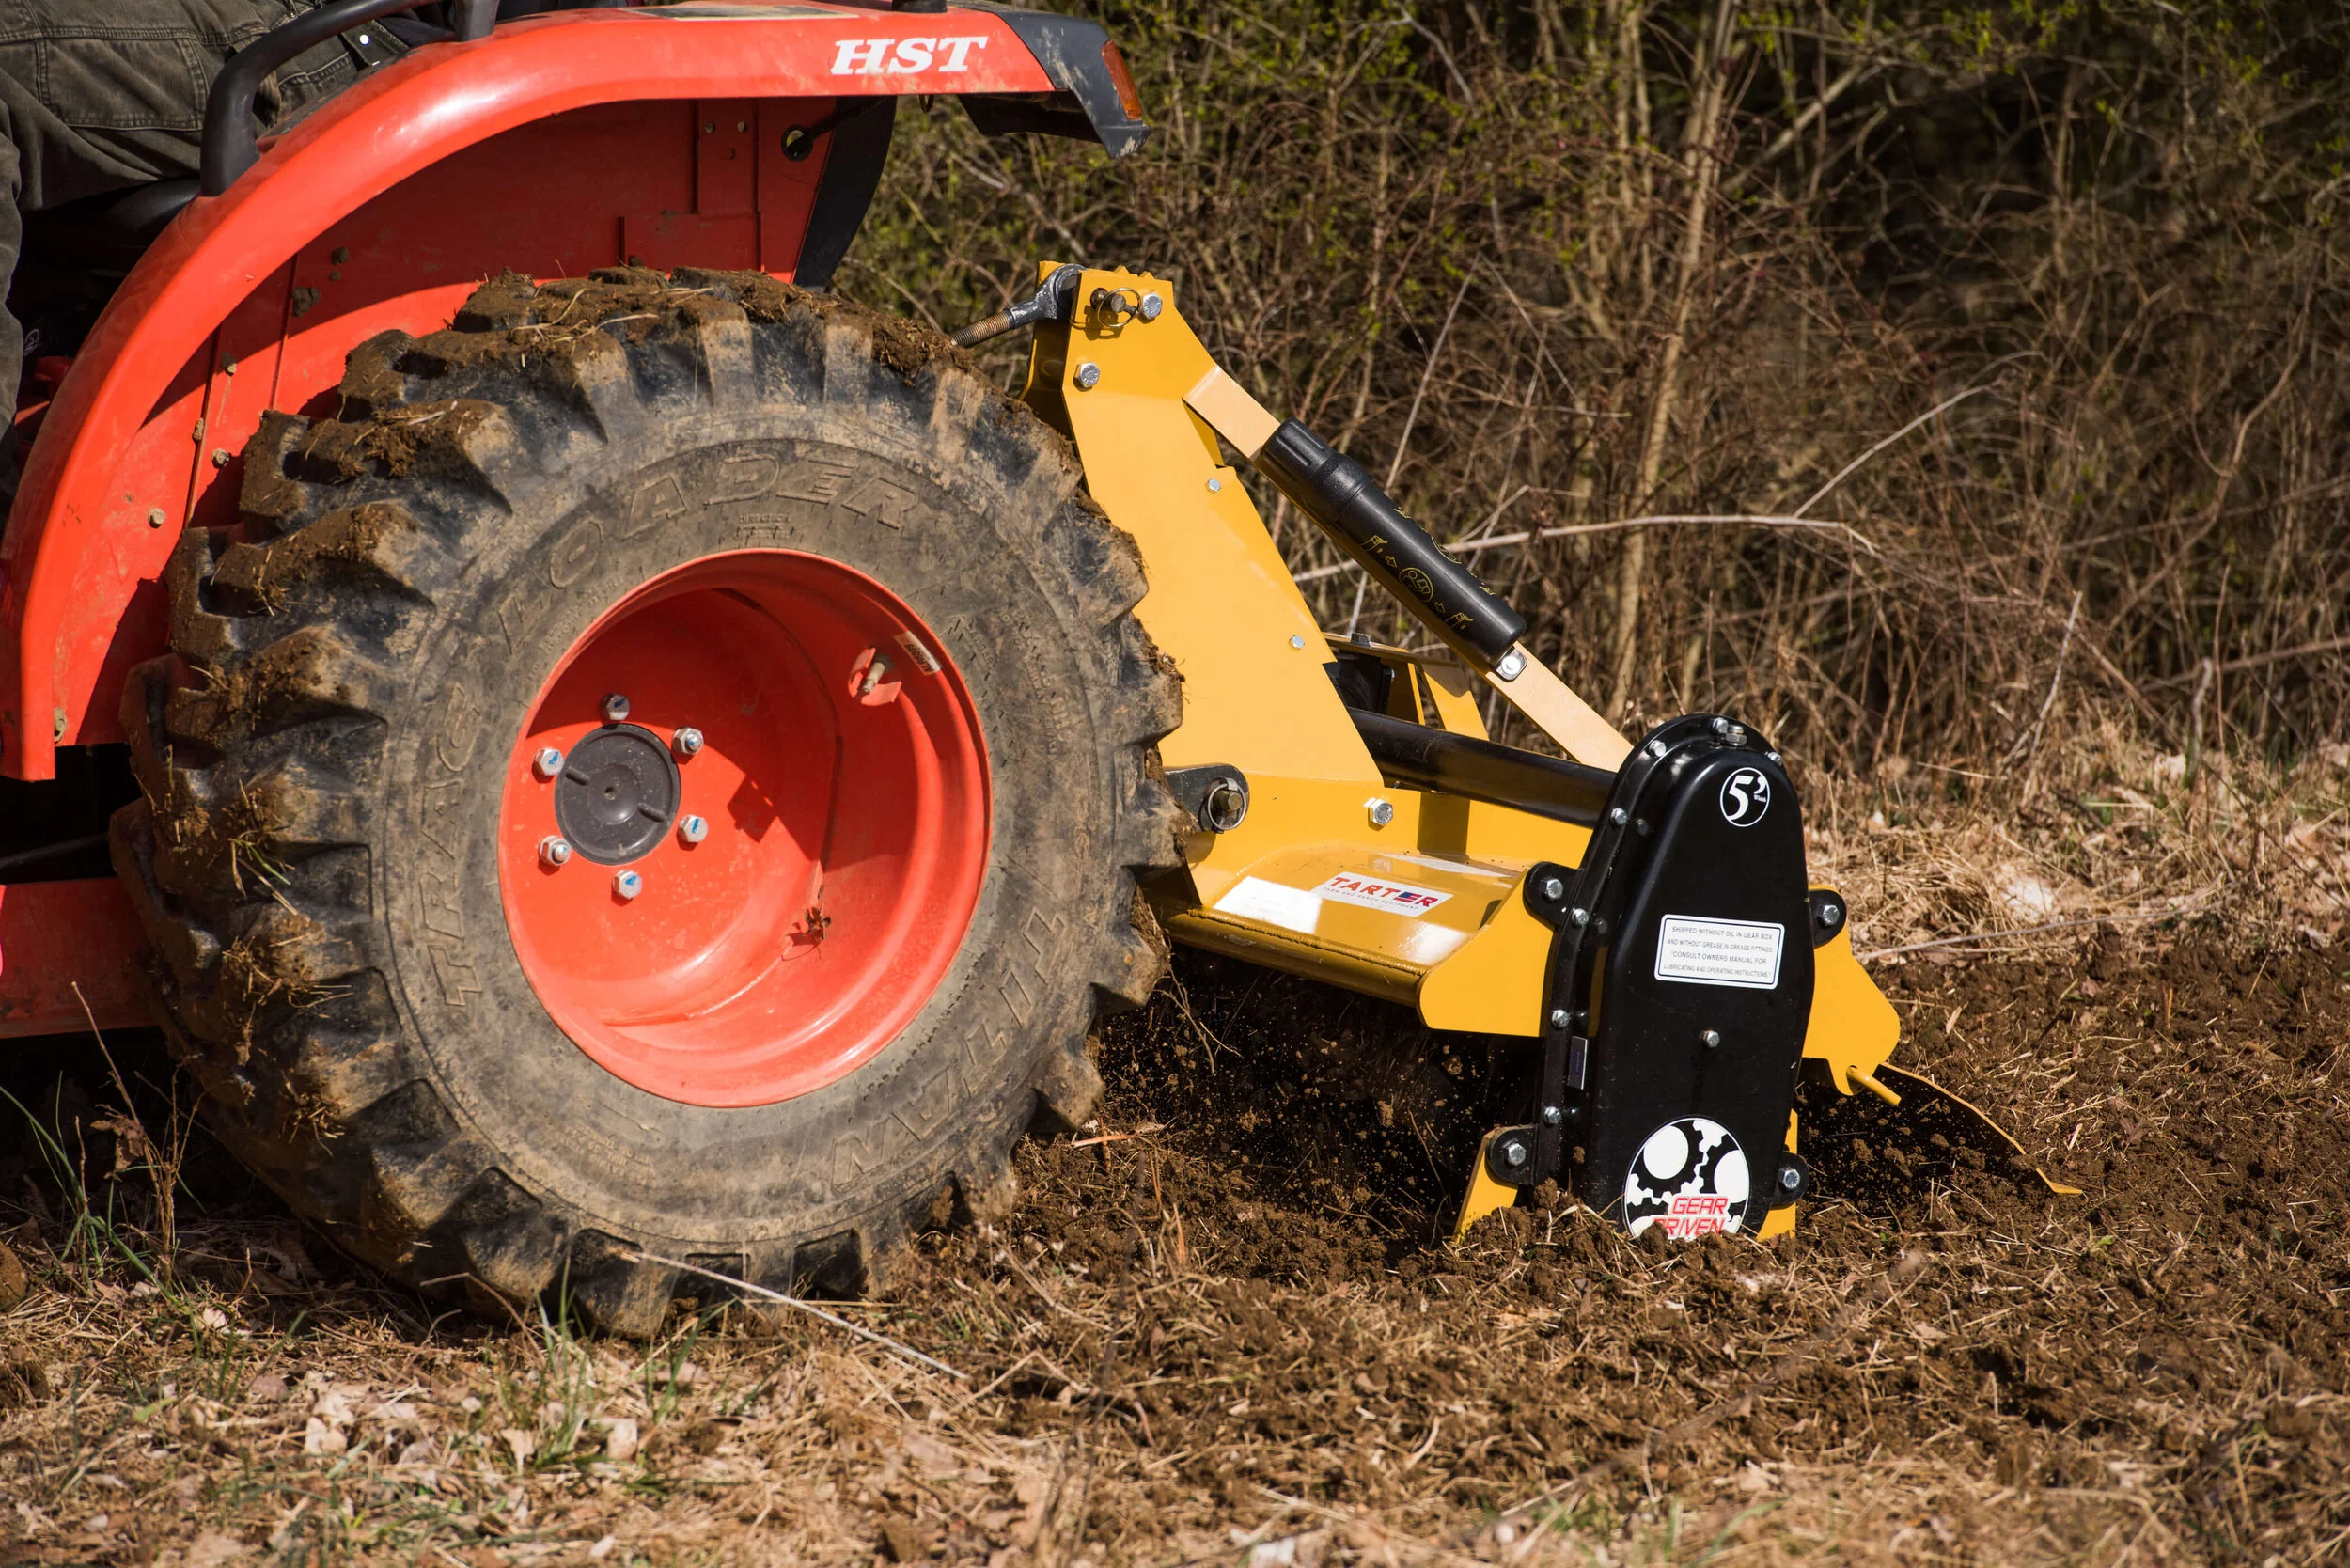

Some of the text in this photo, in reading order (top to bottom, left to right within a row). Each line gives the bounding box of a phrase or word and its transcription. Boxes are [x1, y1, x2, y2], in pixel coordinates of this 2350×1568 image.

[830, 36, 989, 76] HST
[419, 453, 920, 1007] TRAC LOADER
[1330, 876, 1439, 908] TARTER
[1671, 926, 1698, 934] SHIPPED
[1699, 928, 1725, 936] WITHOUT
[1701, 953, 1728, 962] OWNERS
[1663, 963, 1695, 972] LUBRICATING
[831, 904, 1066, 1191] TITAN
[1672, 1198, 1728, 1215] GEAR
[1653, 1218, 1725, 1235] RIVEN
